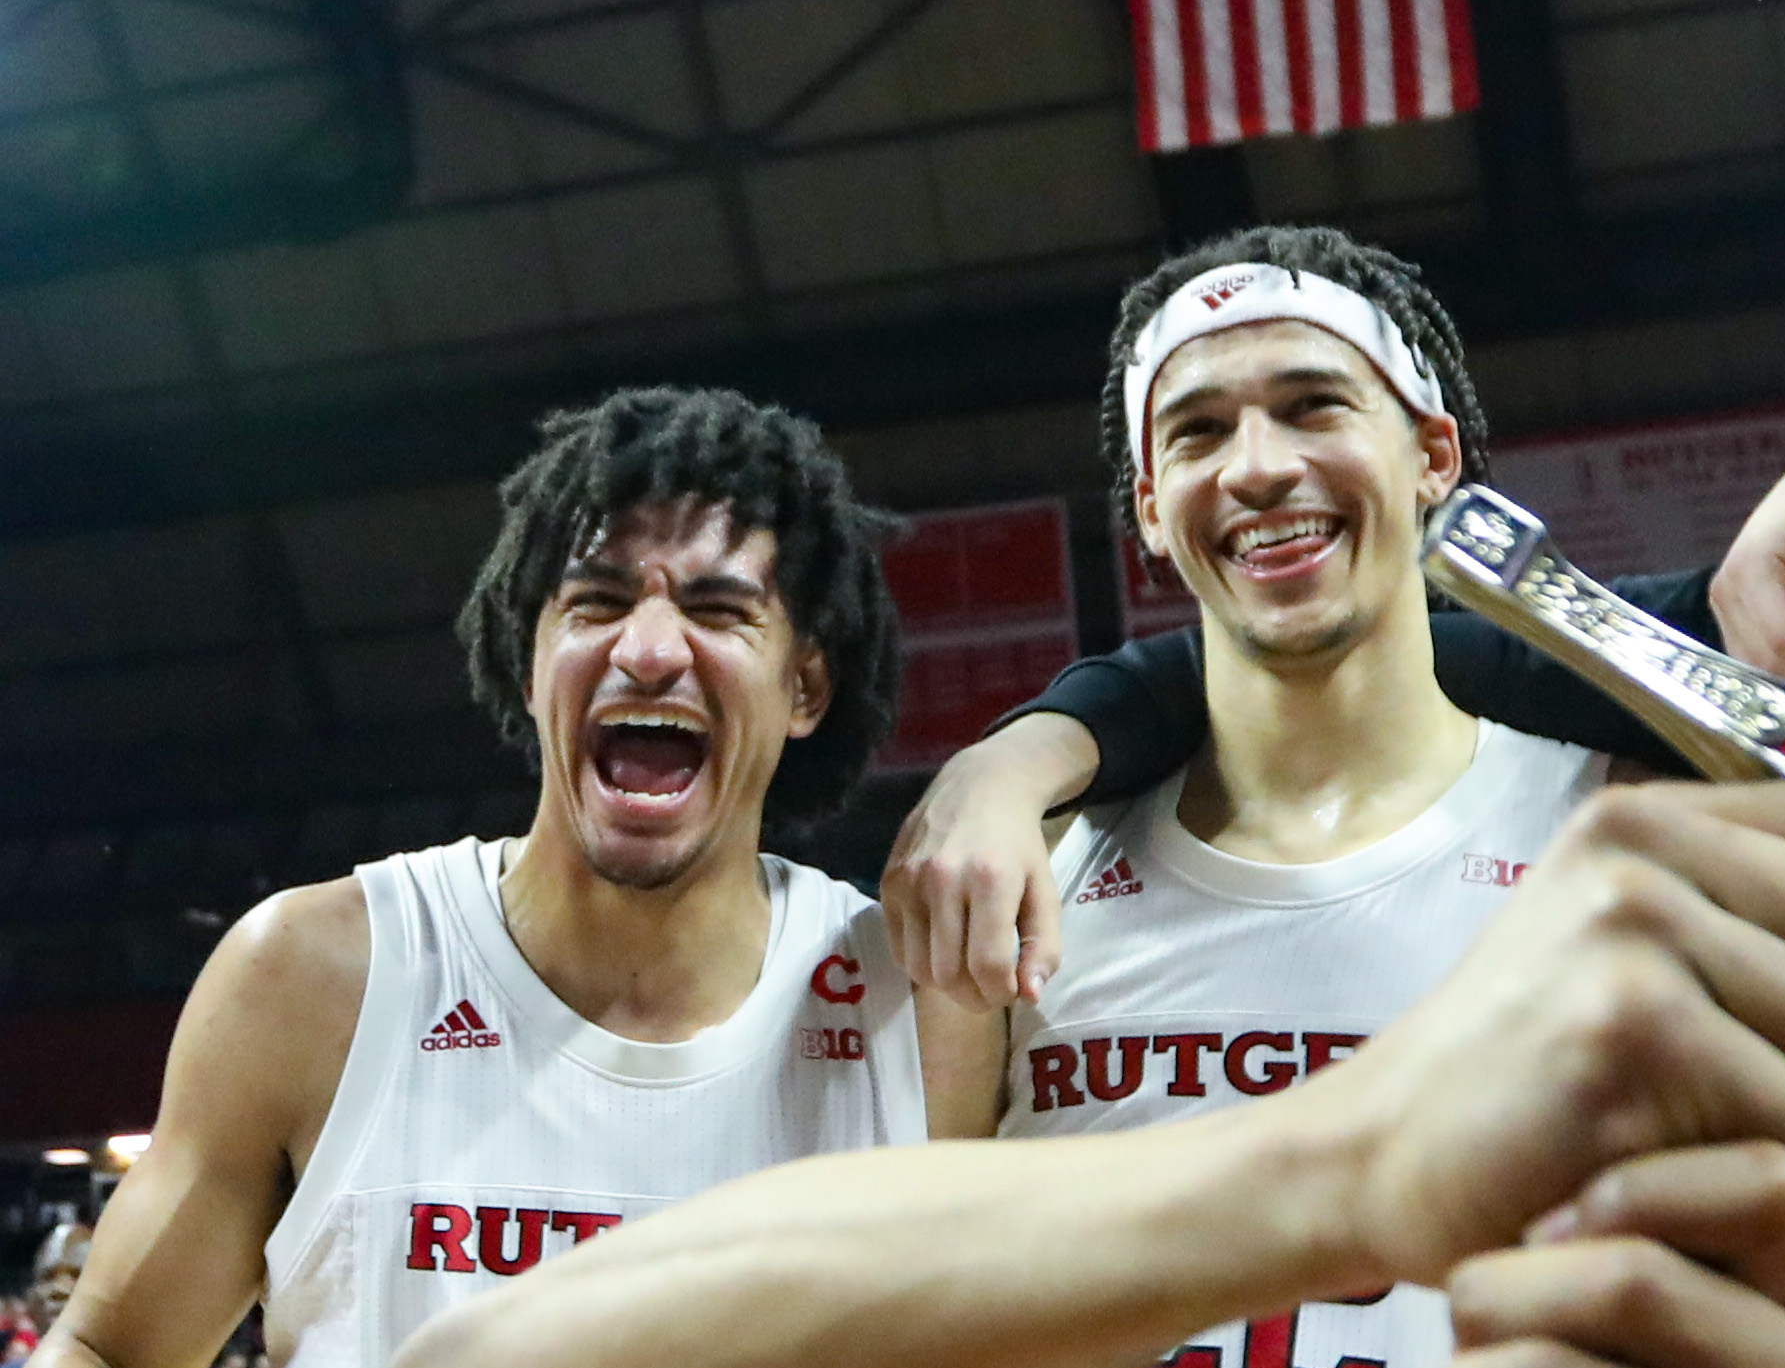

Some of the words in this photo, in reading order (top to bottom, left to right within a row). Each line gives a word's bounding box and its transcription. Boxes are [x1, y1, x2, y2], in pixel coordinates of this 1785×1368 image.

[1077, 880, 1144, 904] adidas
[811, 954, 866, 1005] C
[421, 1031, 501, 1051] adidas
